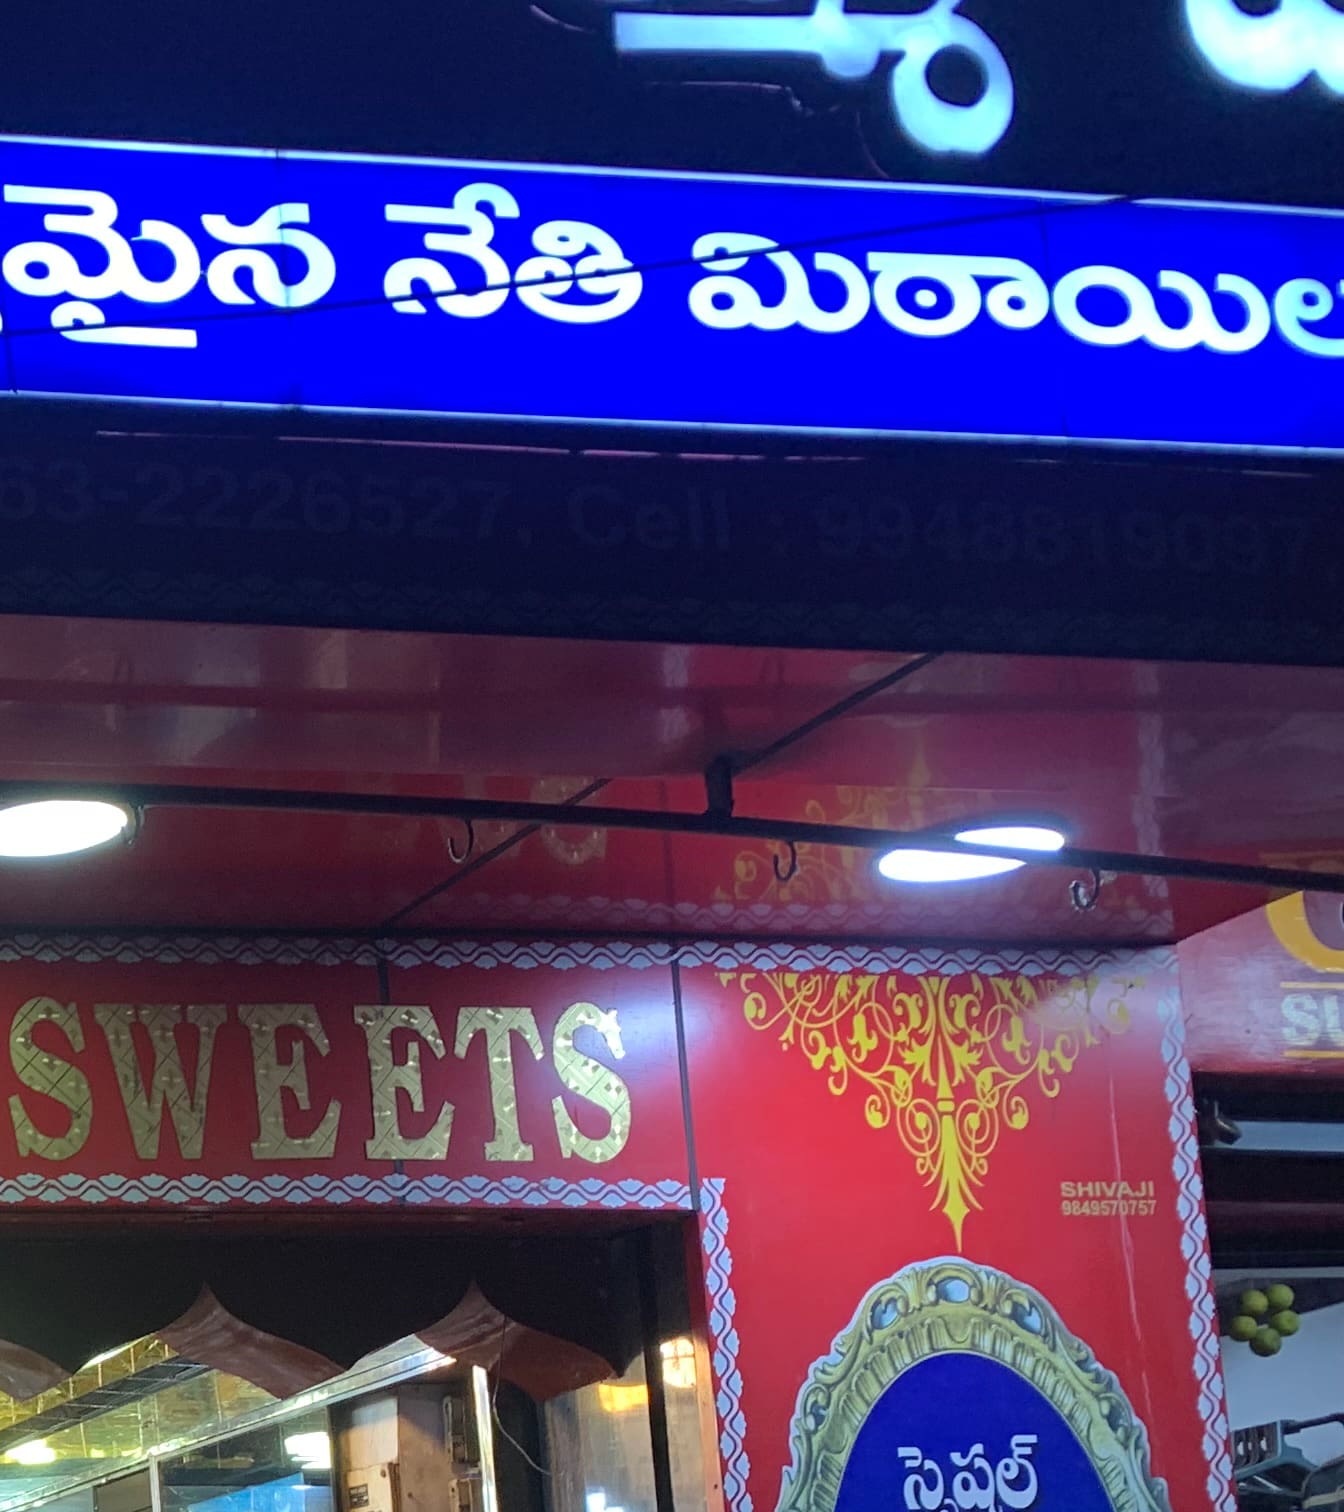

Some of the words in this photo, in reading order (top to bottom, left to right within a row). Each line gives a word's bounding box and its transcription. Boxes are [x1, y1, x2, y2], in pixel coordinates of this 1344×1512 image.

[384, 183, 643, 323] నేతి
[568, 485, 735, 551] Cell
[8, 996, 633, 1165] SWEETS
[1060, 1180, 1155, 1198] SHIVAJI
